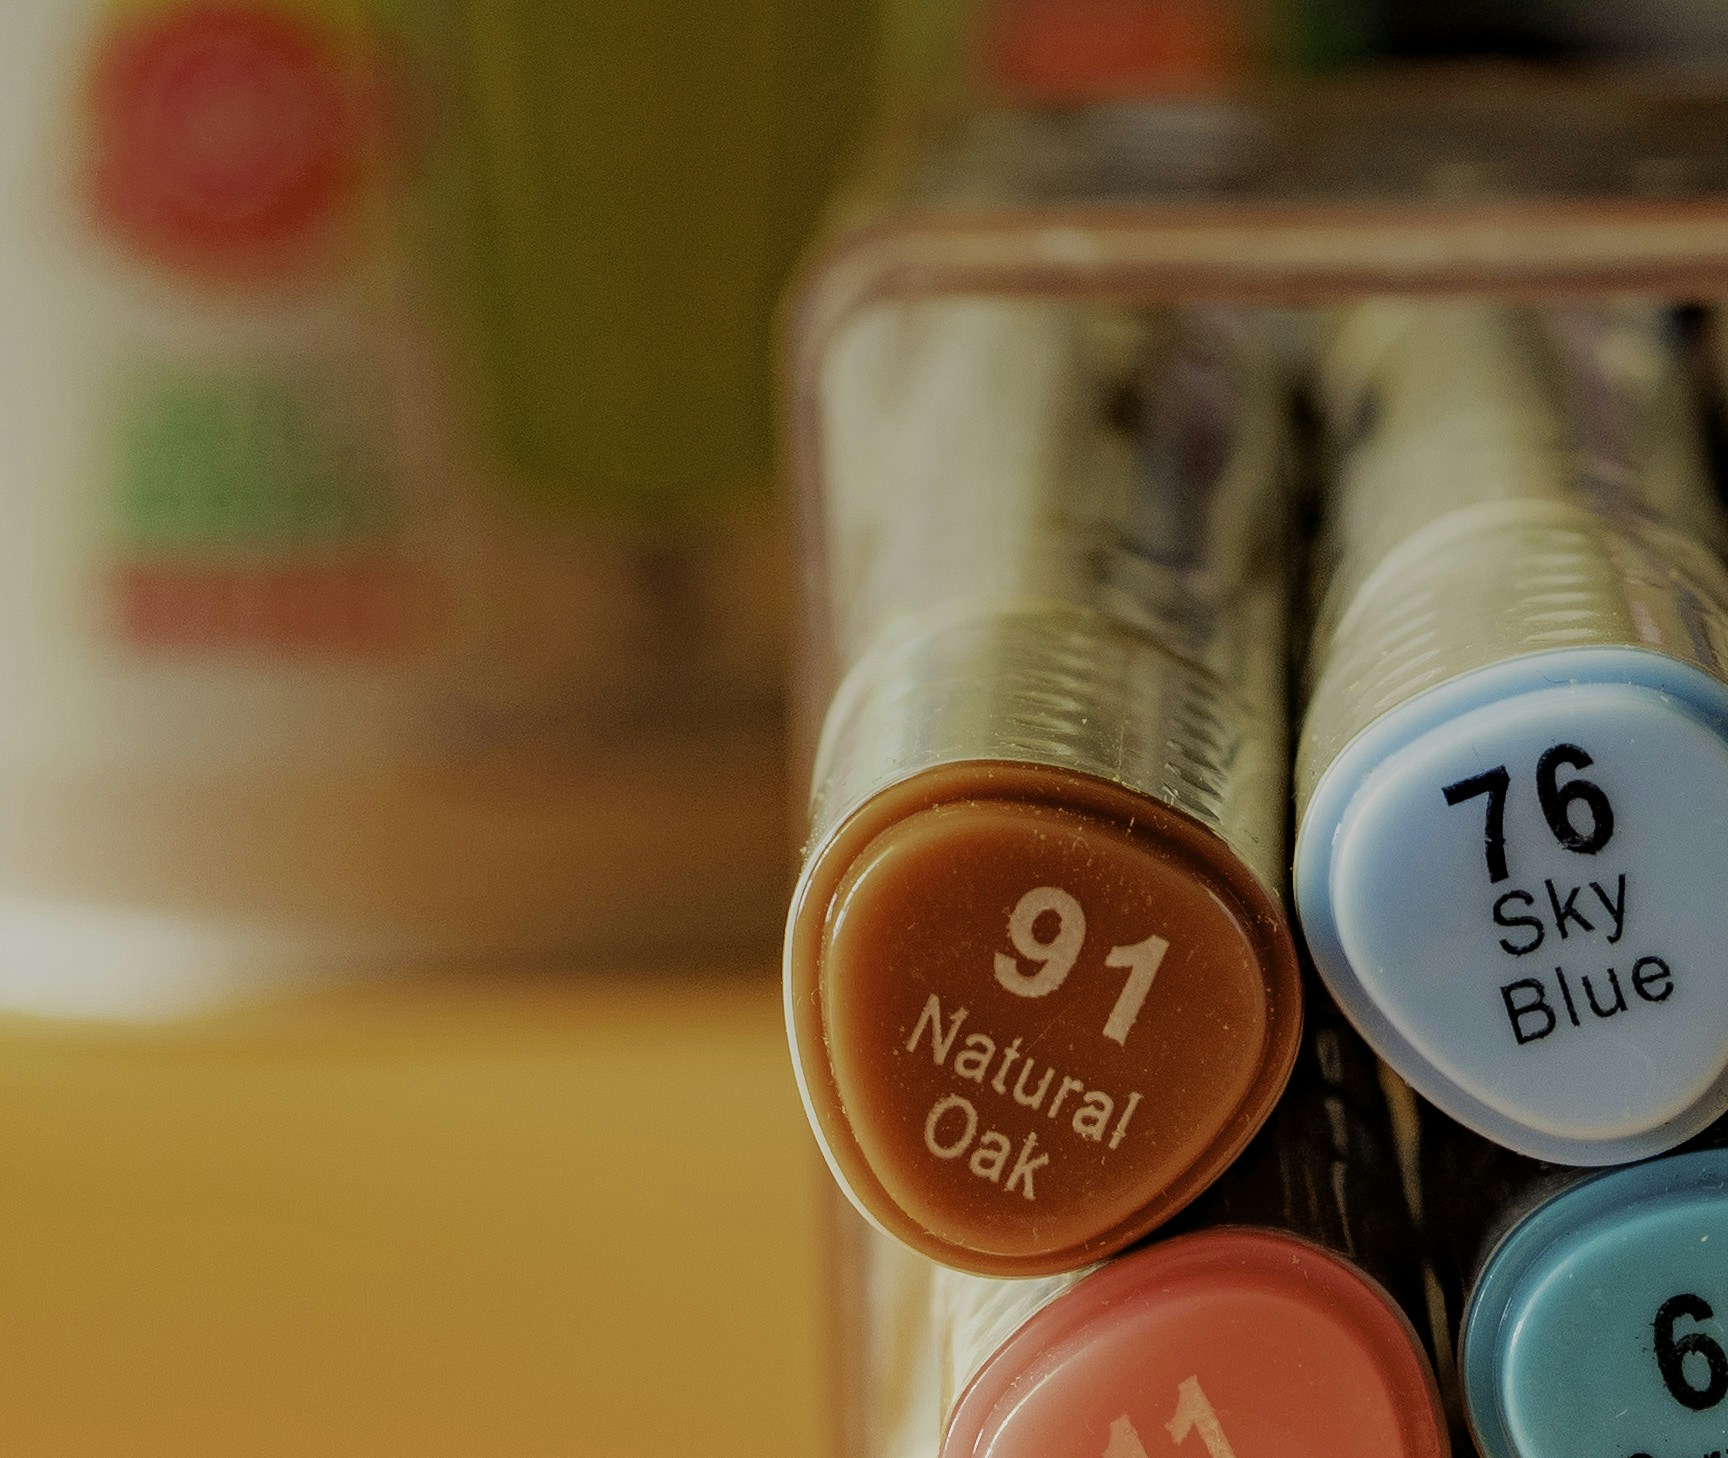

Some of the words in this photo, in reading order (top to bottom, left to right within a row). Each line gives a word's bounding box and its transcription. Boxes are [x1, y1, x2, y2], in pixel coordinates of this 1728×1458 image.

[1442, 743, 1614, 883] 76
[993, 887, 1170, 1046] 91
[1492, 873, 1626, 956] Sky
[1500, 955, 1674, 1045] Blue
[906, 994, 1143, 1149] Natural
[924, 1093, 1049, 1199] Oak
